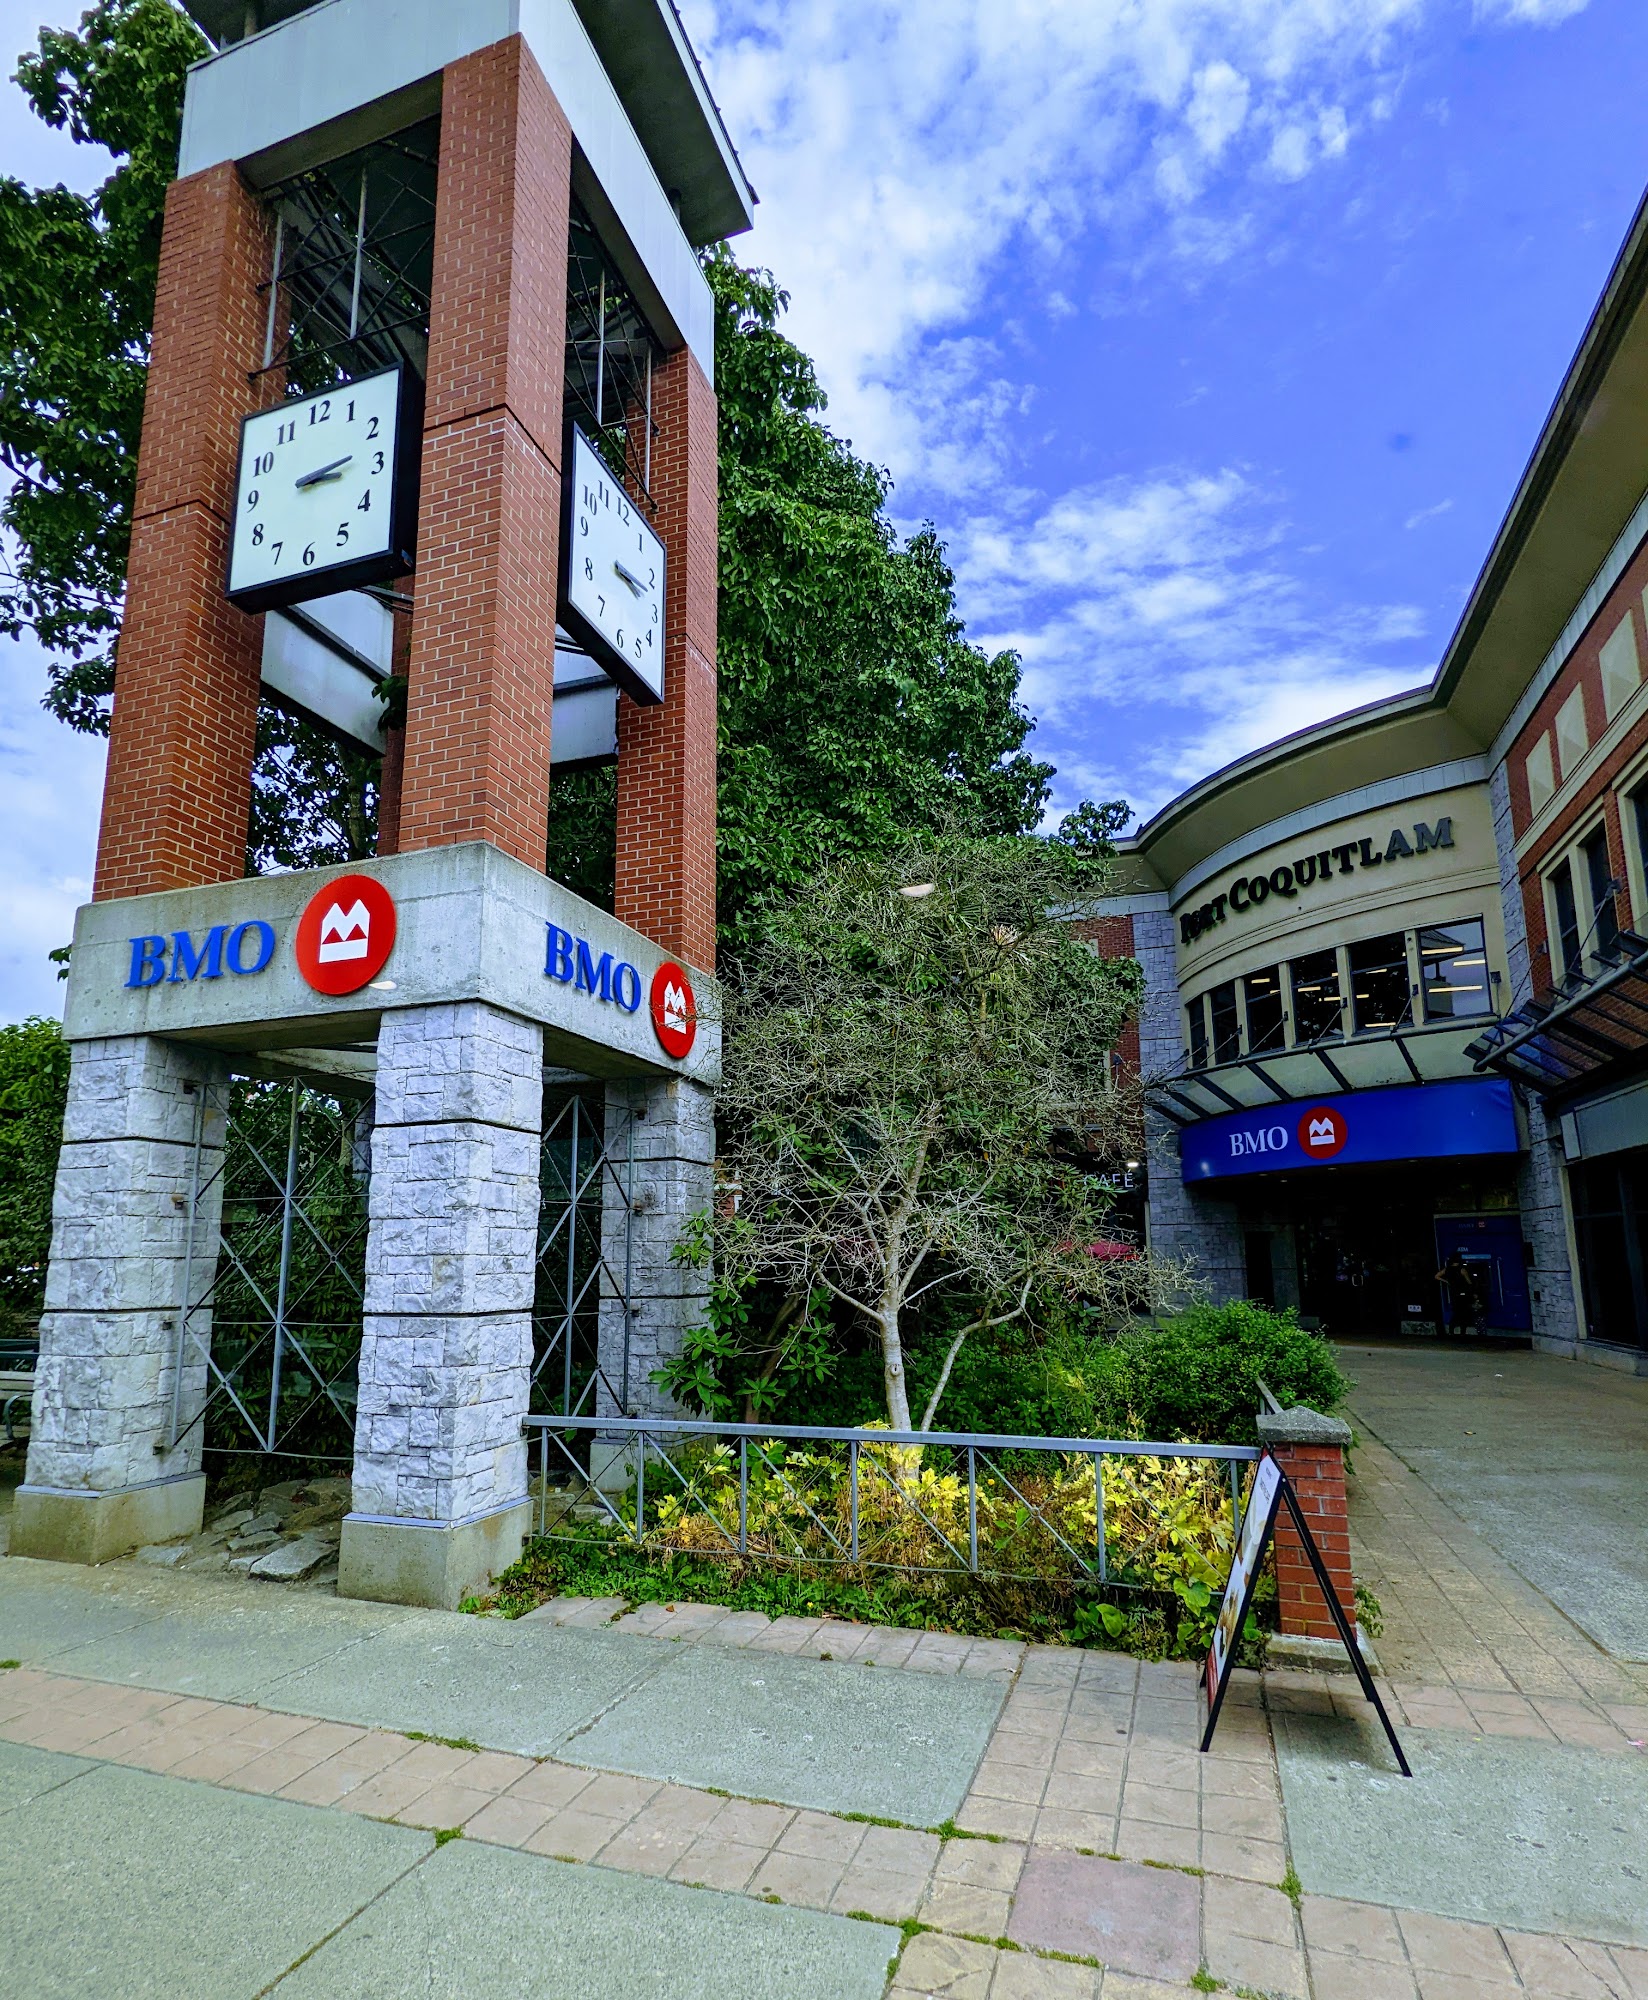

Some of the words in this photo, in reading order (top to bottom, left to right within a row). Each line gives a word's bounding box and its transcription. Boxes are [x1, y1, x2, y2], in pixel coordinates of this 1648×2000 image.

[309, 399, 331, 426] 12
[346, 399, 356, 423] 1
[277, 420, 296, 446] 11
[365, 416, 379, 441] 2
[253, 451, 274, 478] 10
[370, 451, 385, 475] 3
[247, 489, 260, 513] 9
[357, 488, 371, 513] 4
[582, 485, 598, 517] 10
[598, 480, 610, 510] 11
[616, 495, 630, 527] 12
[251, 523, 264, 547] 8
[336, 521, 350, 547] 5
[580, 516, 589, 537] 9
[271, 541, 285, 566] 7
[302, 541, 316, 566] 6
[637, 532, 644, 553] 1
[584, 557, 593, 581] 8
[648, 567, 656, 590] 2
[596, 594, 606, 618] 7
[651, 603, 658, 624] 3
[616, 628, 624, 649] 6
[634, 637, 642, 659] 5
[645, 629, 653, 648] 4
[1180, 893, 1228, 945] PORT
[1229, 816, 1455, 913] COQUITLAM
[124, 920, 276, 988] BMO
[543, 921, 642, 1013] BMO
[1229, 1126, 1289, 1157] BMO
